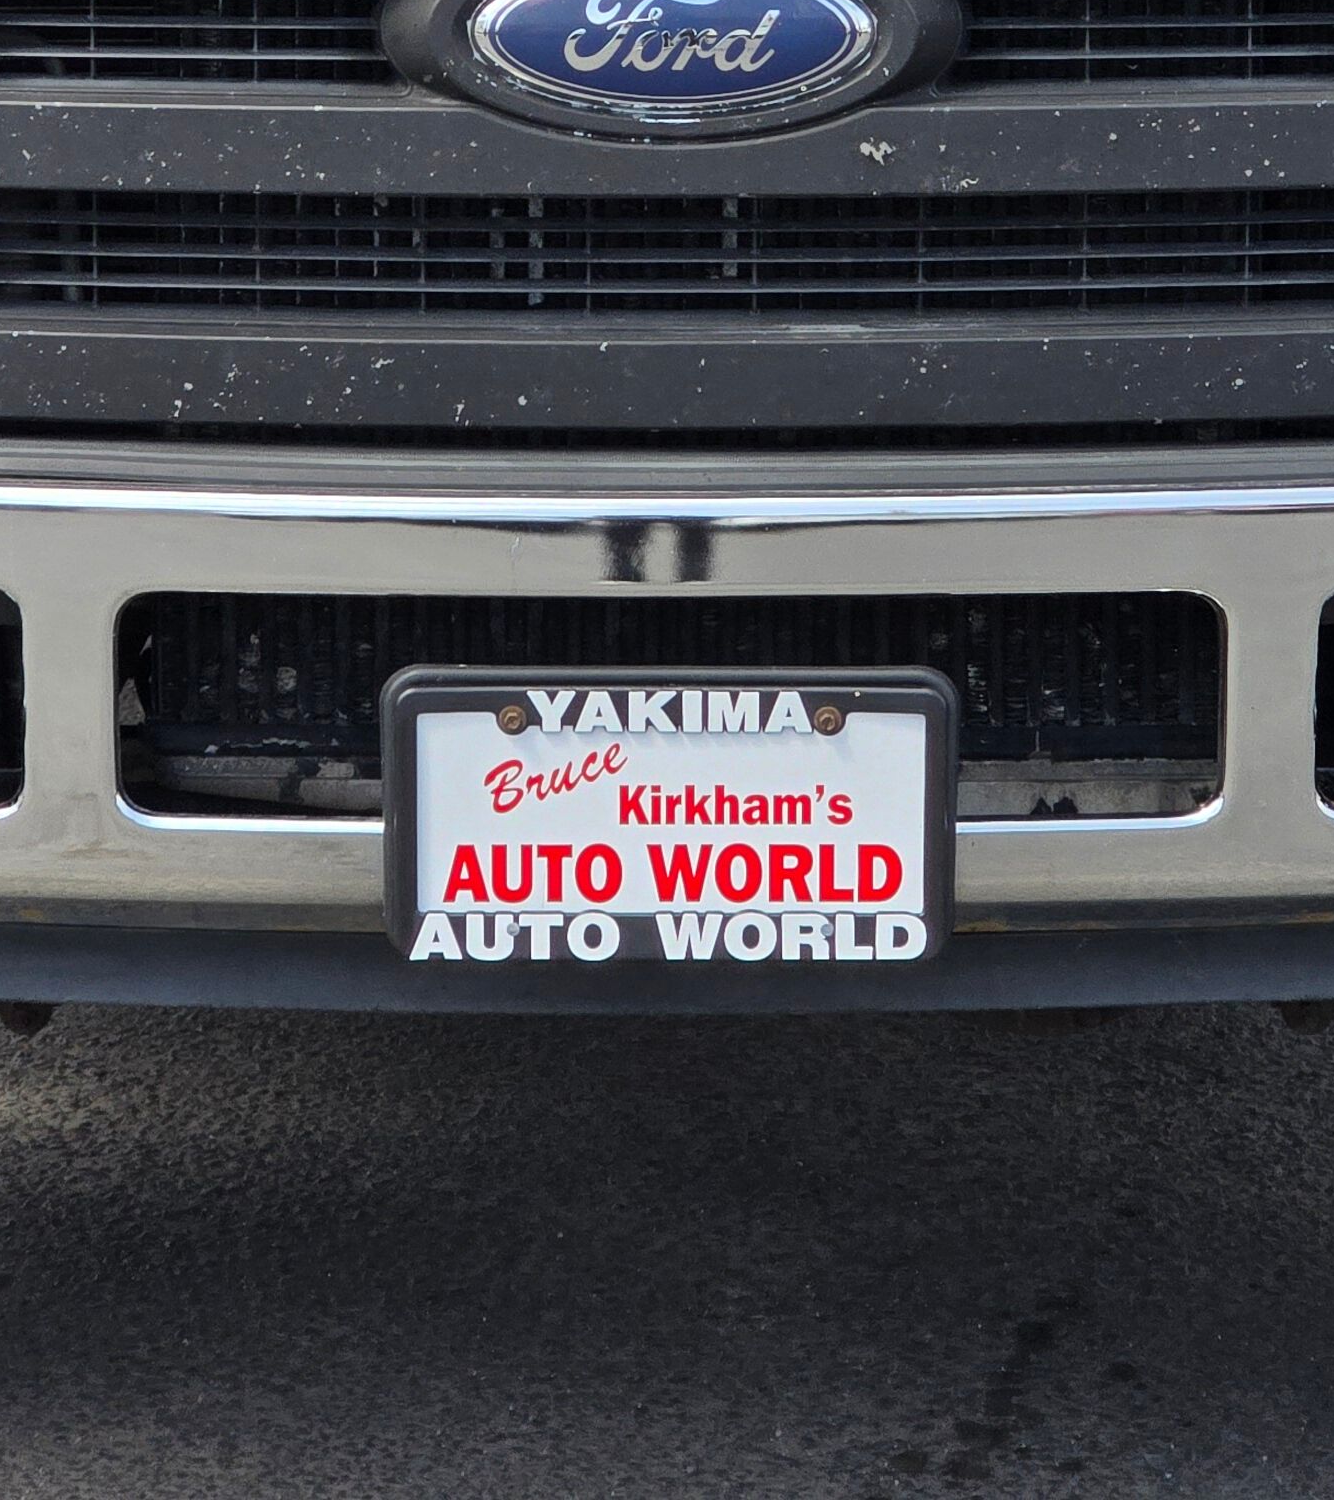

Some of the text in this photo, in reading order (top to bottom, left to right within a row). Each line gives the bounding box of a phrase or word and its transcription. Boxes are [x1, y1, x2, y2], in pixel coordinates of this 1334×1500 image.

[526, 689, 813, 734] YAKIMA
[483, 742, 628, 814] Bruce
[618, 784, 854, 826] Kirkham's
[442, 843, 903, 903] AUTO WORLD
[408, 911, 928, 962] AUTO WORLD
